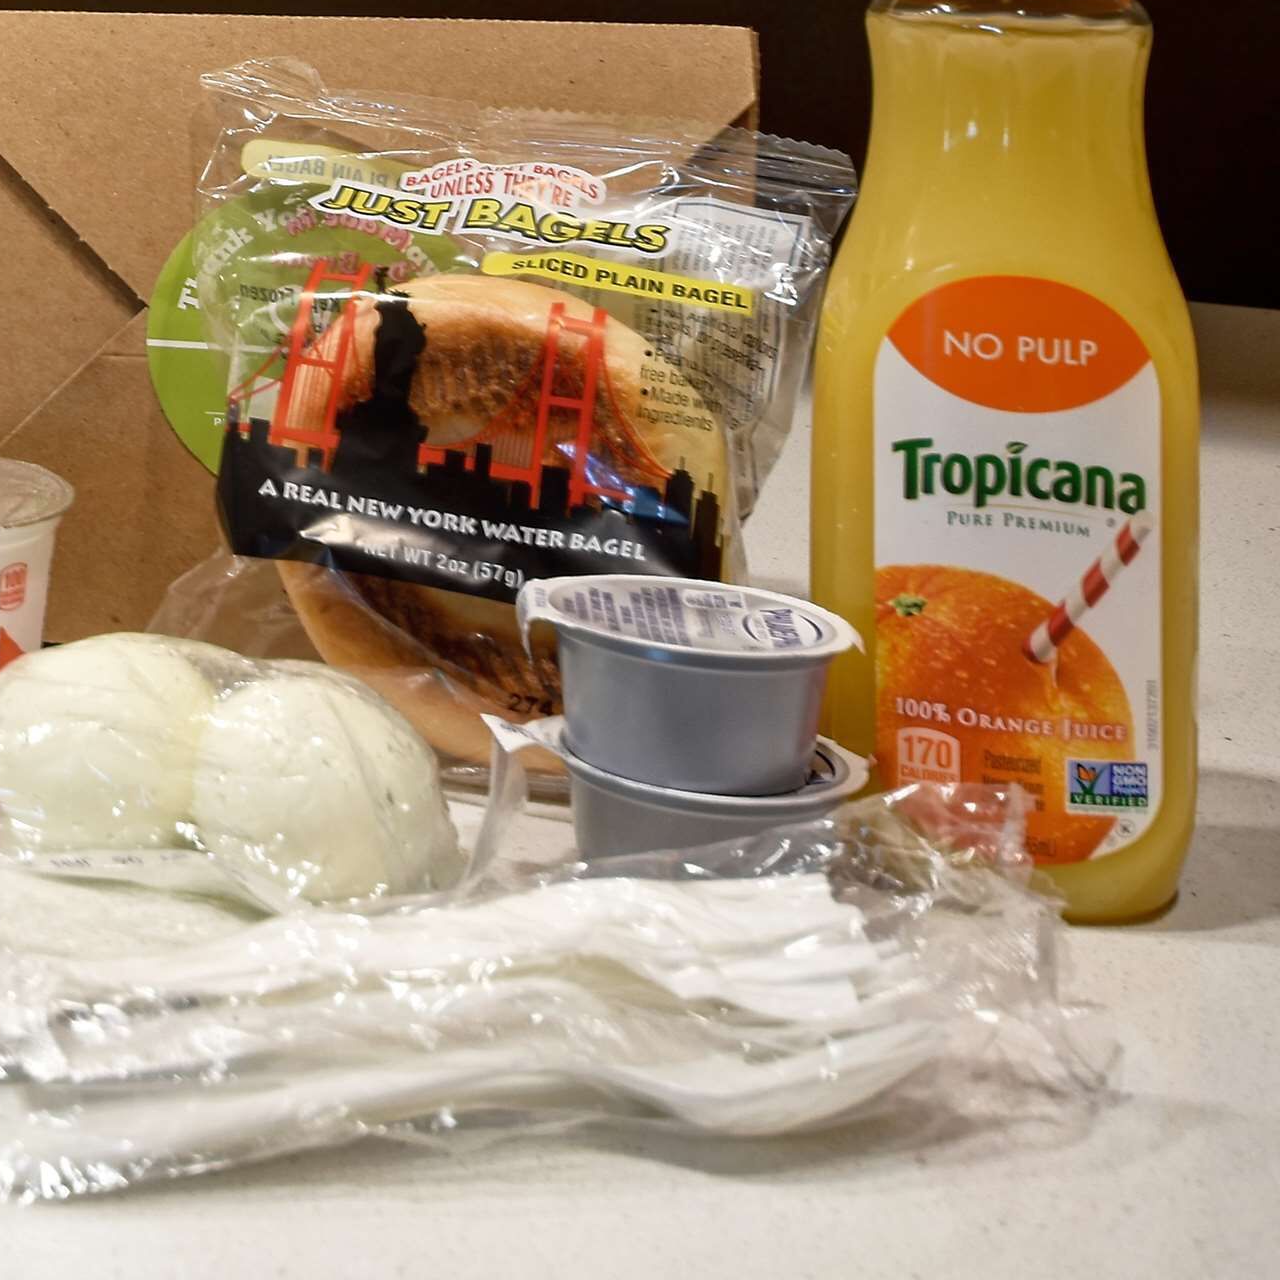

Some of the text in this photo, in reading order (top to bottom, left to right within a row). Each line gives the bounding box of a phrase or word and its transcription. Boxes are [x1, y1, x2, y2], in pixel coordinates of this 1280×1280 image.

[405, 160, 598, 199] BAGELS BAGELS
[430, 171, 493, 199] UNLESS
[319, 185, 453, 230] JUST
[462, 197, 672, 253] BAGELS
[511, 258, 750, 310] SLICED PLAIN BAGEL
[943, 330, 1100, 368] NO PULP
[650, 386, 689, 407] Made
[890, 437, 1148, 516] Tropicana
[257, 478, 647, 562] A REAL NEW YORK WATER BAGEL
[946, 510, 1091, 538] PURE PREMIUM
[401, 545, 433, 568] WT
[436, 552, 468, 576] 2oz
[472, 559, 526, 588] (57g)
[894, 695, 1130, 742] 100% ORANGE JUICE
[902, 734, 953, 769] 170
[1112, 764, 1148, 777] NON
[1072, 795, 1148, 808] VERIFIED
